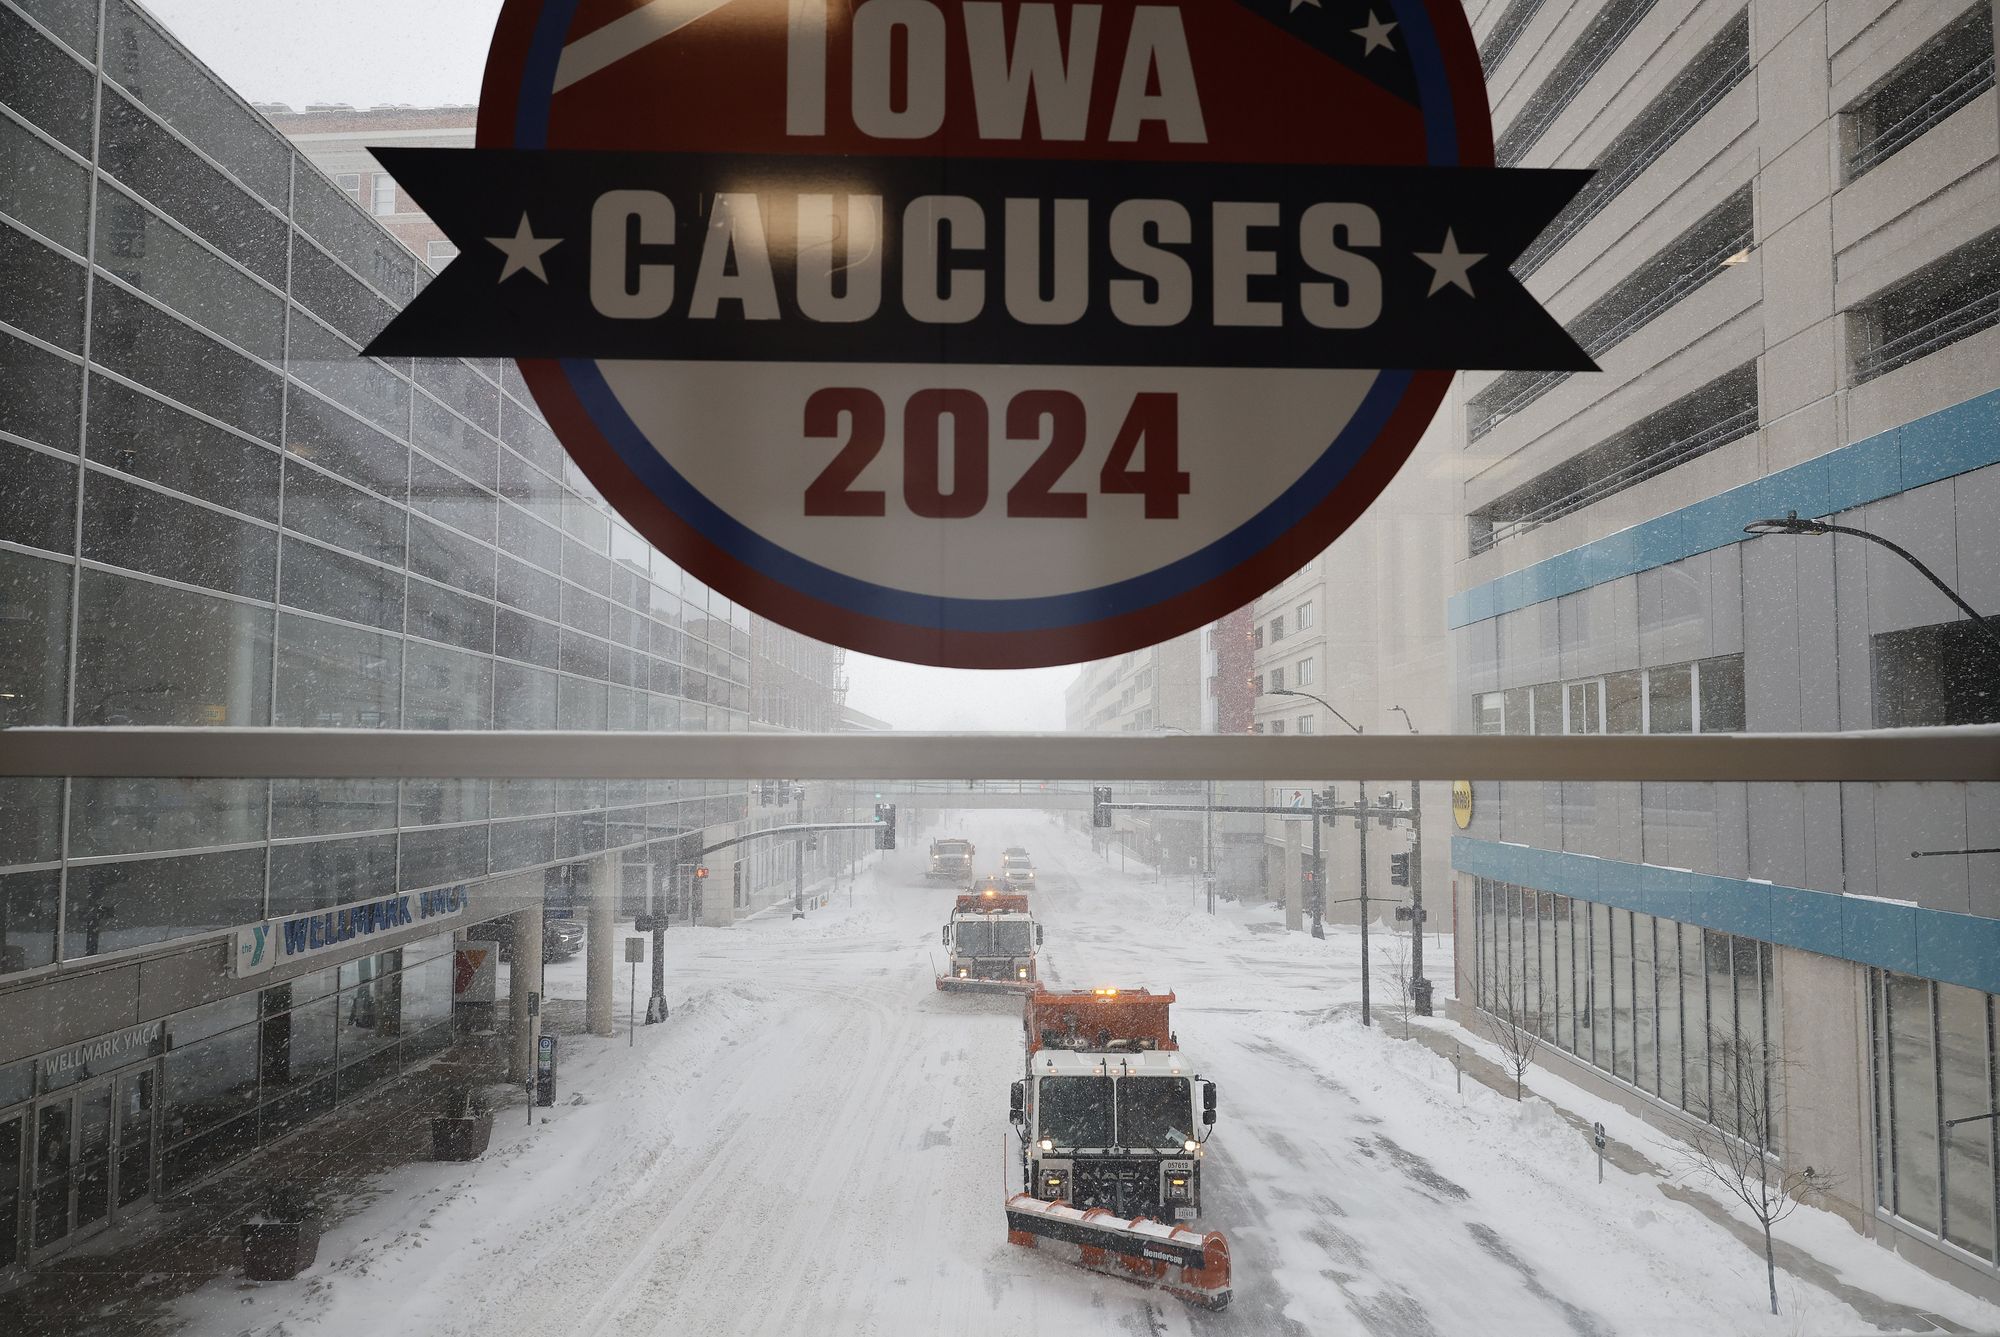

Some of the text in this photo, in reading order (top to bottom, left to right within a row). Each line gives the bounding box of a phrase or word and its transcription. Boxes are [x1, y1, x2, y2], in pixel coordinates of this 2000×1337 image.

[786, 0, 1208, 144] IOWA
[589, 189, 1383, 330] CAUCUSES
[803, 387, 1190, 519] 2024
[284, 885, 468, 956] WELLMARK YMCA
[46, 1024, 159, 1075] WELLMARK YMCA
[1143, 1248, 1183, 1264] Henderson
